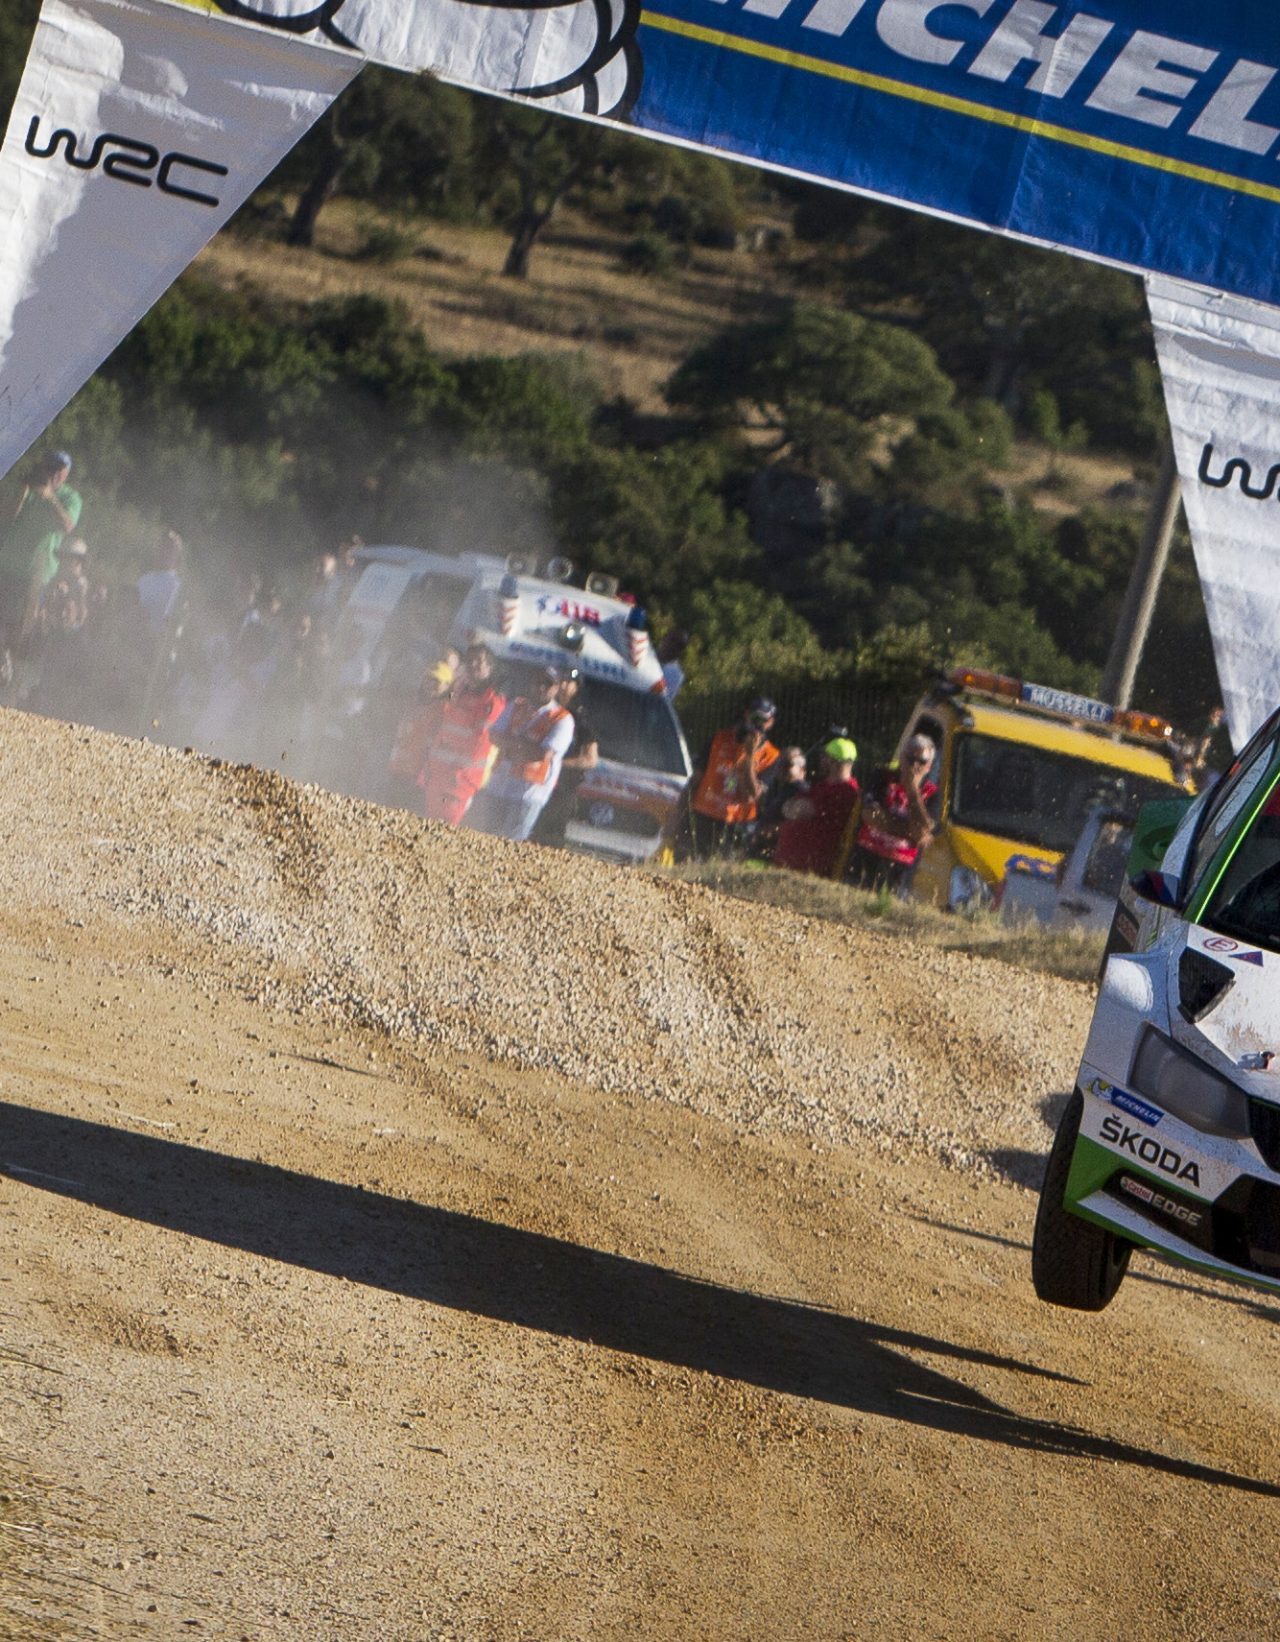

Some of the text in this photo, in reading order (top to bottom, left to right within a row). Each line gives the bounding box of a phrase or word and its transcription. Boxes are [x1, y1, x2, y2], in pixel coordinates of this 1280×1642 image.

[25, 115, 229, 207] WRC
[1114, 1094, 1163, 1122] MICHELIN
[1099, 1112, 1201, 1188] ŠKODA
[1151, 1193, 1202, 1226] EDGE
